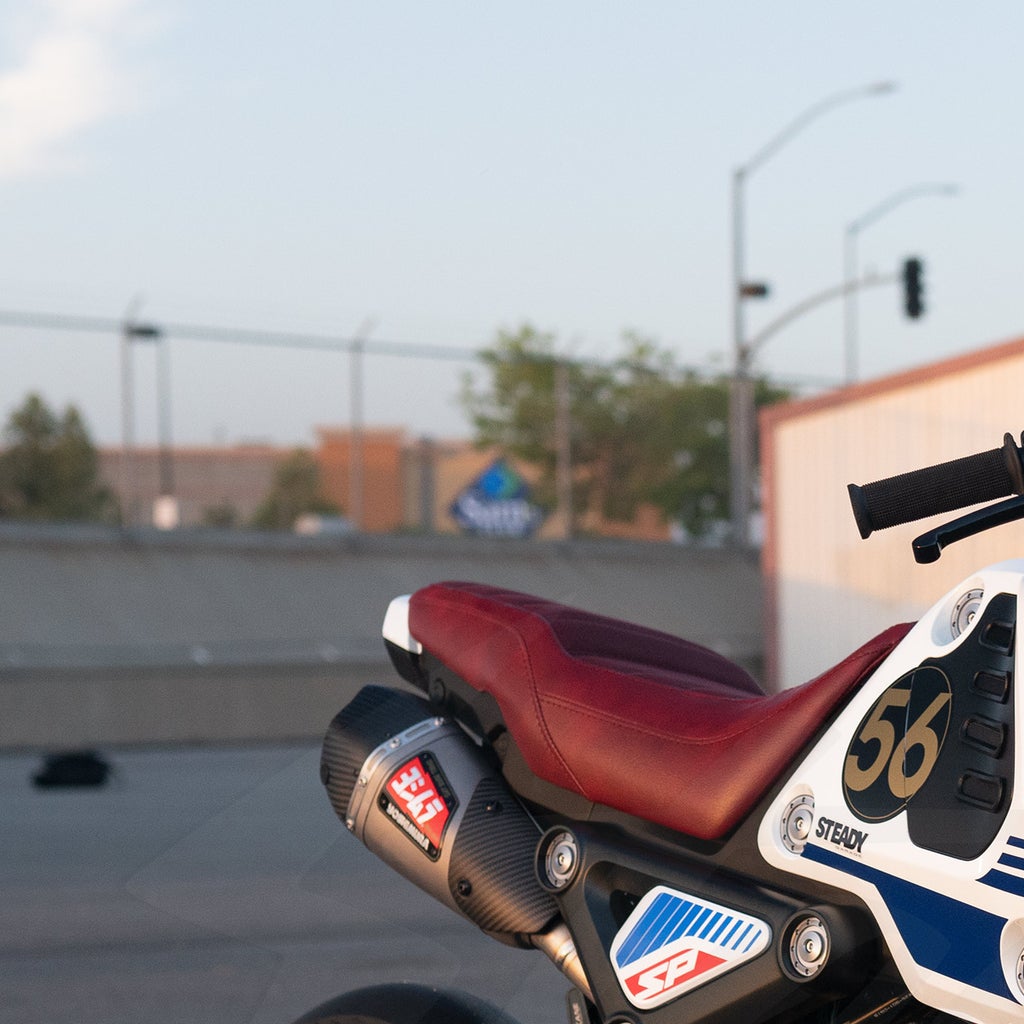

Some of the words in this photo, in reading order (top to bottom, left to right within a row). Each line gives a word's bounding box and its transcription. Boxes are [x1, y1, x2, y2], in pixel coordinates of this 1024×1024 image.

[844, 687, 953, 799] 56
[816, 816, 869, 854] STEADY
[637, 949, 700, 993] SP
